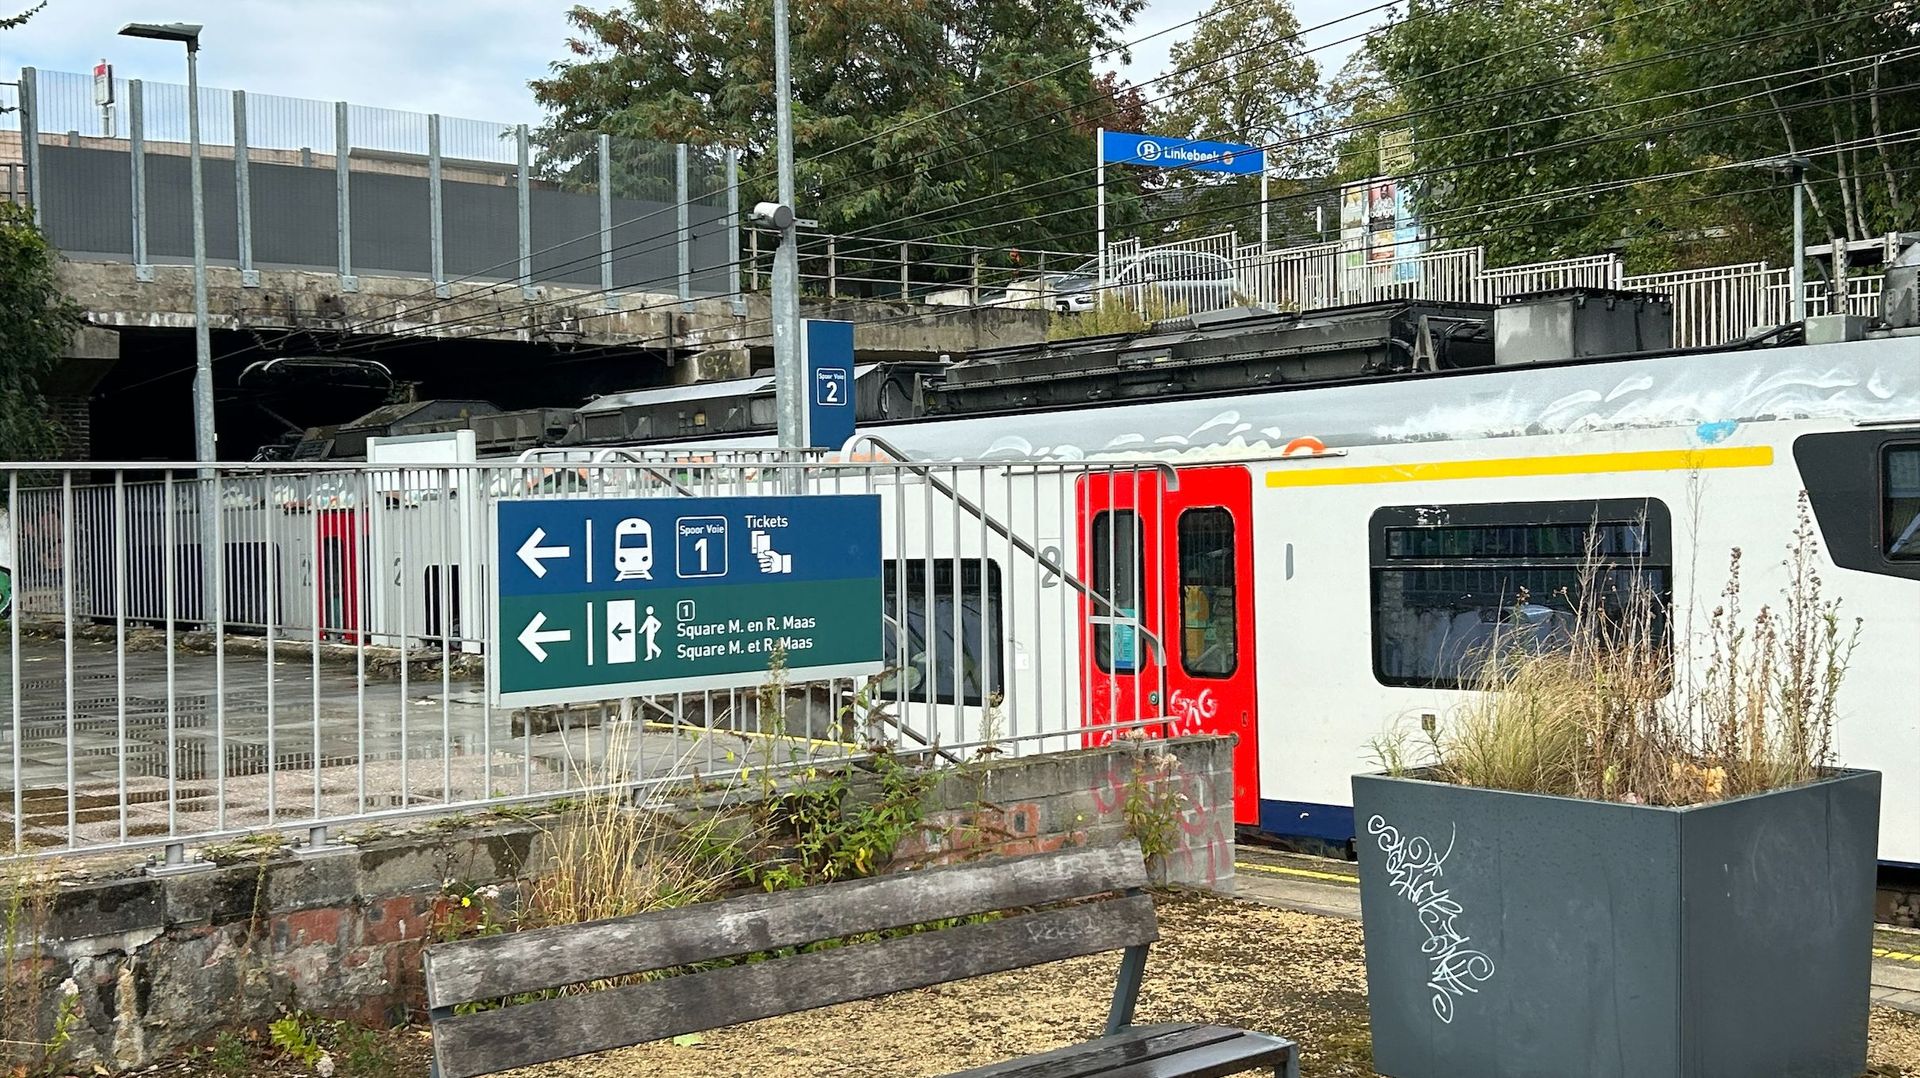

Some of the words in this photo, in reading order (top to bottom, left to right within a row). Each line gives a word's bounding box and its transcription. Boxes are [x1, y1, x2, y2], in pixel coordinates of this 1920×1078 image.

[826, 381, 838, 402] 2
[679, 525, 704, 537] Spoor
[706, 524, 725, 534] Voie
[744, 514, 789, 529] Tickets
[694, 538, 708, 571] 1
[1041, 545, 1062, 588] 2
[393, 557, 402, 587] 2
[682, 604, 690, 617] 1
[676, 623, 725, 640] Square
[728, 619, 744, 634] M.
[747, 621, 763, 633] en
[766, 616, 780, 631] R.
[783, 615, 816, 630] Maas
[677, 643, 726, 661] Square
[728, 640, 745, 655] M.
[747, 639, 760, 653] et
[763, 637, 777, 652] R.
[780, 636, 813, 650] Maas
